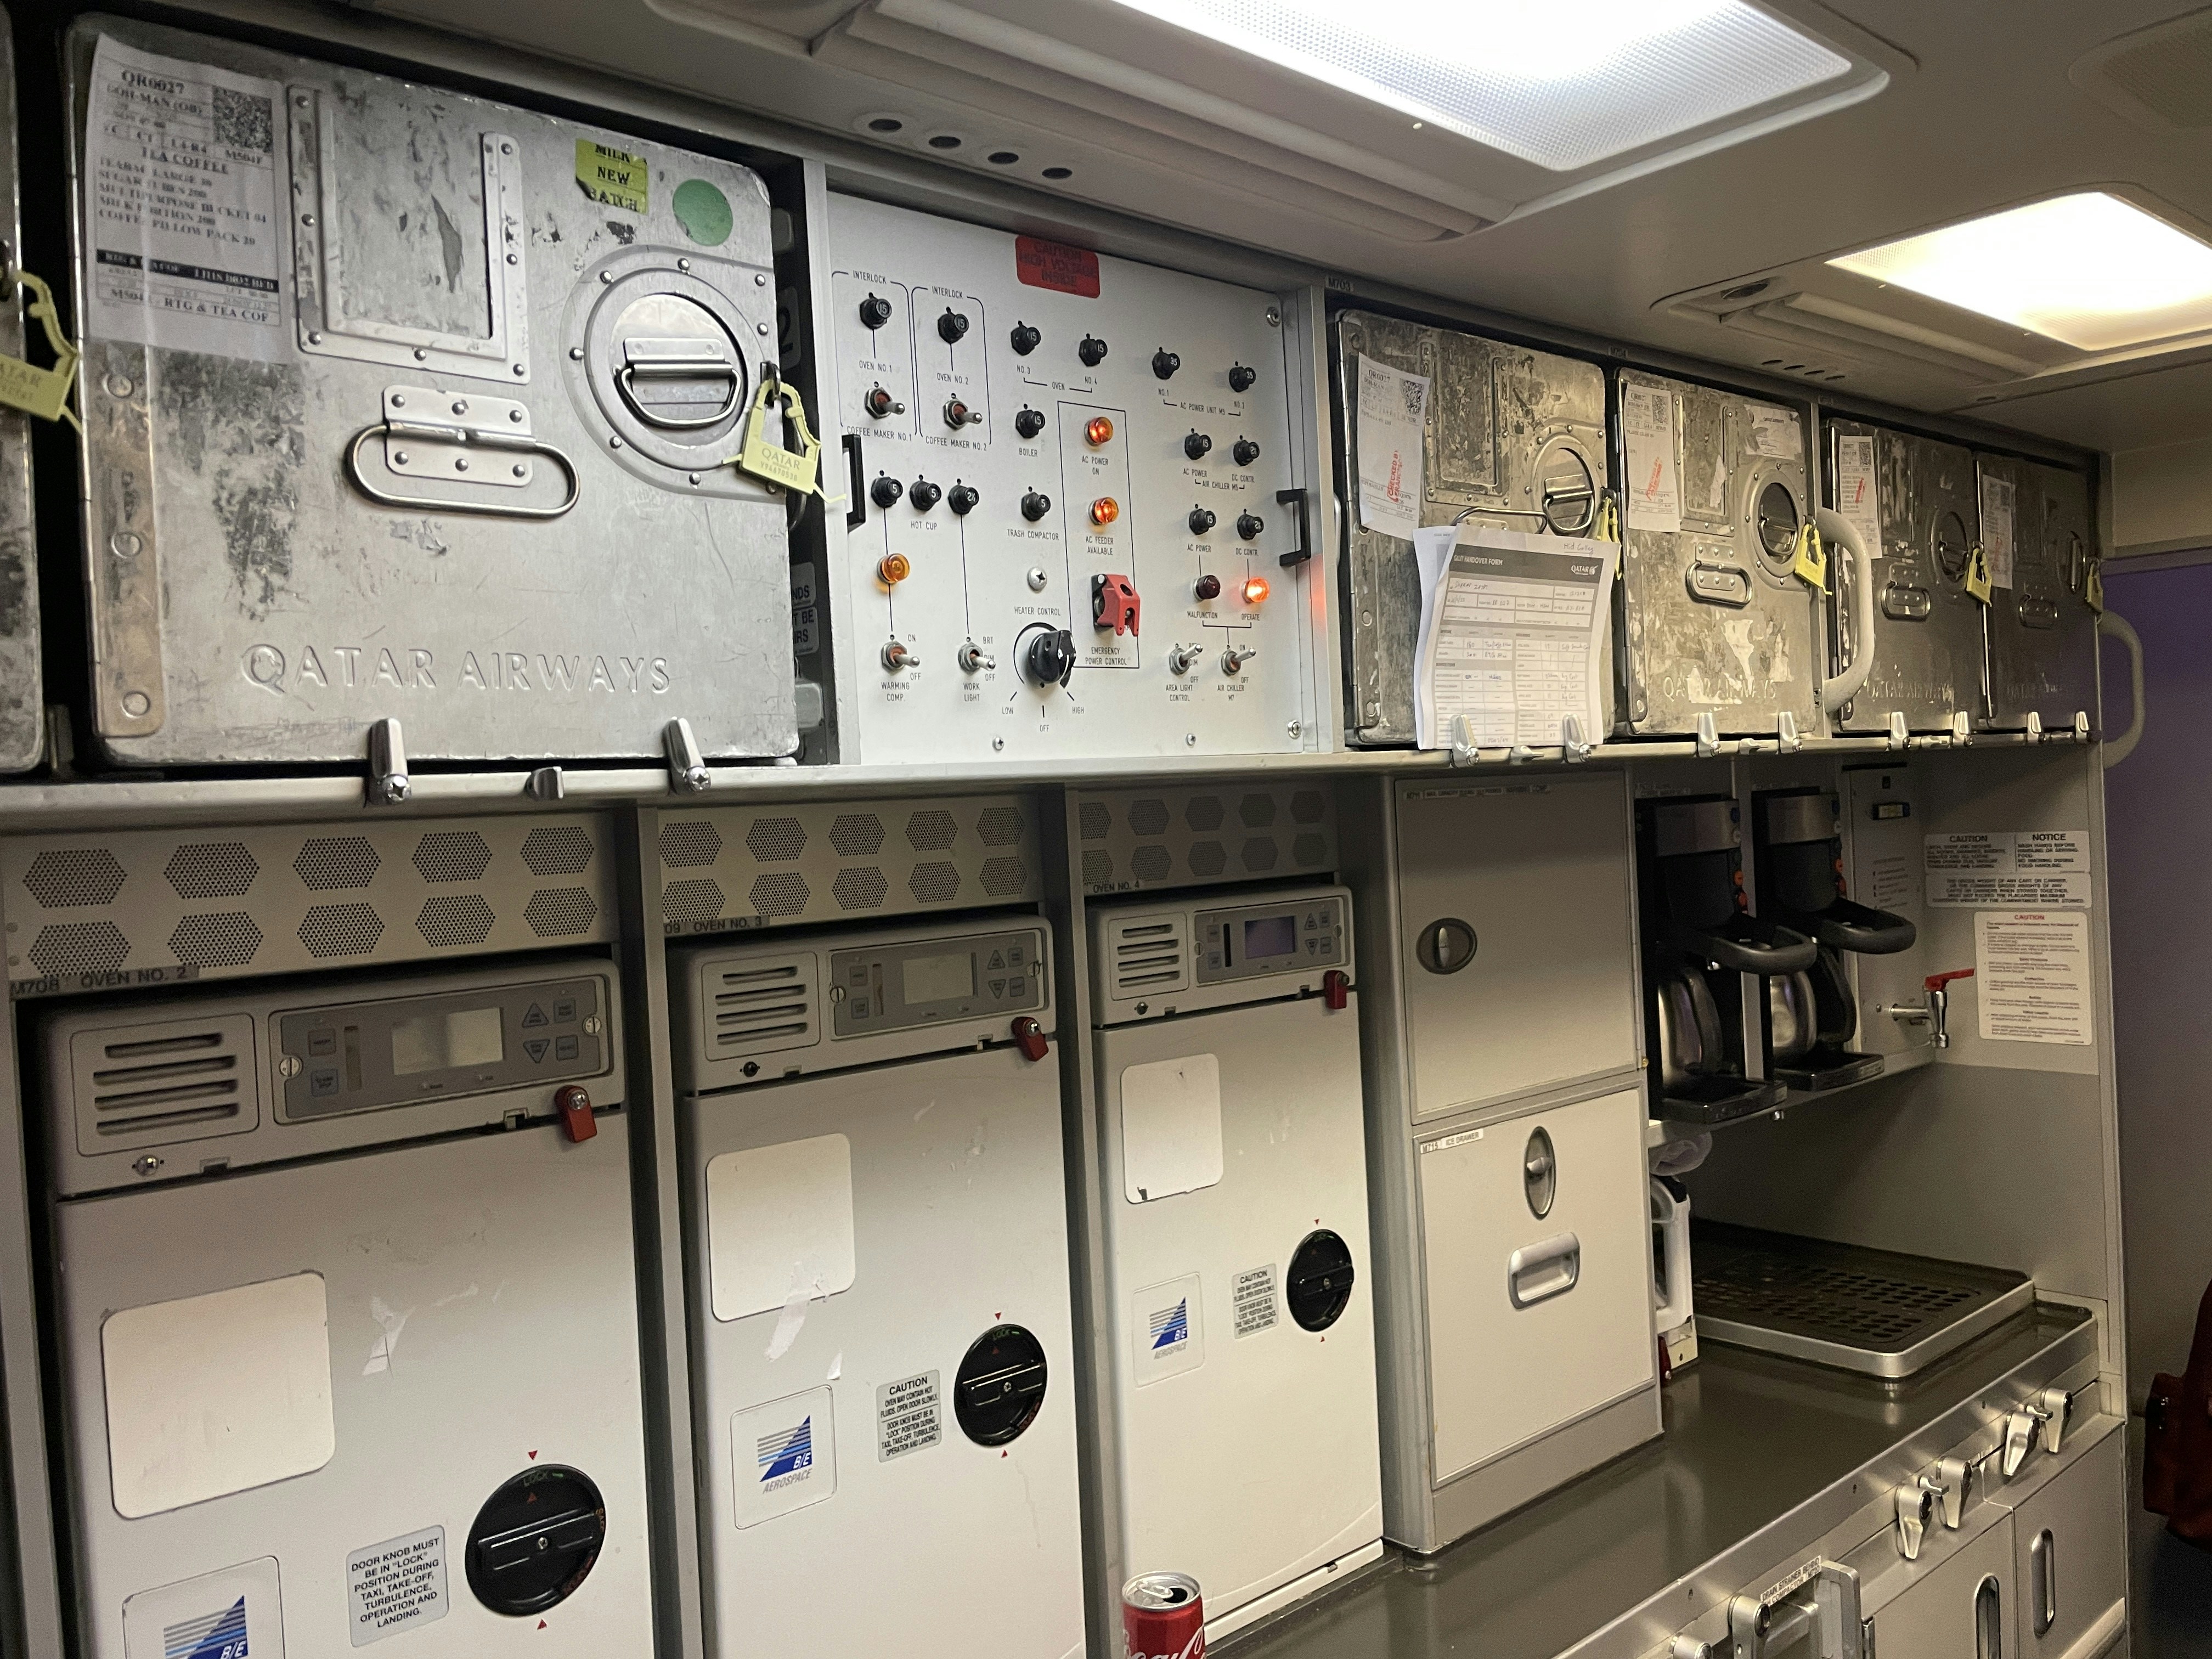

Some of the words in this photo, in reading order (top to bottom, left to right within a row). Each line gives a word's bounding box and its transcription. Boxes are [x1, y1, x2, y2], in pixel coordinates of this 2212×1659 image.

[597, 166, 630, 185] NEW
[853, 270, 887, 284] INTERLOCK
[932, 286, 963, 299] INTERLOCK
[957, 319, 965, 328] 15
[1030, 332, 1037, 341] 15
[1097, 344, 1104, 353] 15
[859, 360, 874, 370] OVEN
[936, 373, 951, 382] OVEN
[1052, 381, 1065, 391] OVEN
[1189, 403, 1204, 412] POWER
[1034, 415, 1041, 425] 15
[847, 426, 871, 437] COFFEE
[874, 430, 894, 439] MAKER
[926, 436, 947, 447] COFFEE
[950, 439, 970, 449] MAKER
[1019, 447, 1038, 458] BOILER
[761, 447, 800, 470] QATAR
[1082, 455, 1089, 464] AC
[1091, 457, 1109, 466] POWER
[1092, 467, 1099, 476] ON
[1192, 469, 1207, 477] POWER
[892, 484, 898, 494] 5
[1212, 481, 1230, 490] CHILLER
[932, 488, 937, 499] 5
[1041, 499, 1046, 508] 5
[1207, 515, 1213, 524] 15
[911, 521, 922, 529] HOT
[924, 522, 937, 531] CUP
[1007, 528, 1025, 538] TRASH
[1027, 531, 1059, 541] COMPACTOR
[1095, 537, 1114, 546] FEEDER
[1087, 546, 1113, 556] AVAILABLE
[1196, 544, 1212, 552] POWER
[1571, 565, 1589, 573] QATAR
[1014, 606, 1035, 615] HEATER
[1037, 607, 1061, 617] CONTROL
[1187, 611, 1218, 619] MALFUNCTION
[983, 636, 993, 645] BRT
[1091, 647, 1120, 655] EMERGENCY
[1085, 657, 1103, 665] POWER
[241, 644, 437, 693] QATAR
[457, 651, 670, 694] AIRWAYS
[910, 673, 922, 681] OFF
[881, 681, 910, 691] WARMING
[963, 682, 980, 691] WORK
[964, 693, 980, 702] LIGHT
[1002, 706, 1014, 715] LOW
[1072, 706, 1085, 714] HIGH
[1040, 724, 1049, 732] OFF
[2032, 833, 2067, 841] NOTICE
[1093, 882, 1115, 894] OVEN
[1118, 882, 1132, 890] NO.
[1135, 880, 1139, 888] 4
[693, 919, 725, 932] OVEN
[730, 917, 751, 929] NO.
[755, 916, 761, 927] 3
[81, 971, 130, 989] OVEN
[138, 968, 168, 983] NO.
[176, 966, 188, 979] 2
[1240, 1269, 1267, 1284] CAUTION
[889, 1376, 928, 1395] CAUTION
[793, 1452, 811, 1469] B/E
[763, 1468, 812, 1494] AEROSPACE
[352, 1556, 380, 1572] DOOR
[383, 1547, 410, 1562] KNOB
[413, 1537, 439, 1553] MUST
[365, 1568, 377, 1578] BE
[381, 1564, 390, 1573] IN
[392, 1551, 428, 1568] "LOCK"
[354, 1572, 399, 1593] POSITION
[402, 1559, 439, 1577] DURING
[387, 1571, 435, 1593] TAKE-OFF,
[360, 1598, 415, 1623] OPERATION
[417, 1591, 437, 1604] AND
[377, 1608, 422, 1628] LANDING.
[220, 1640, 246, 1659] B/E
